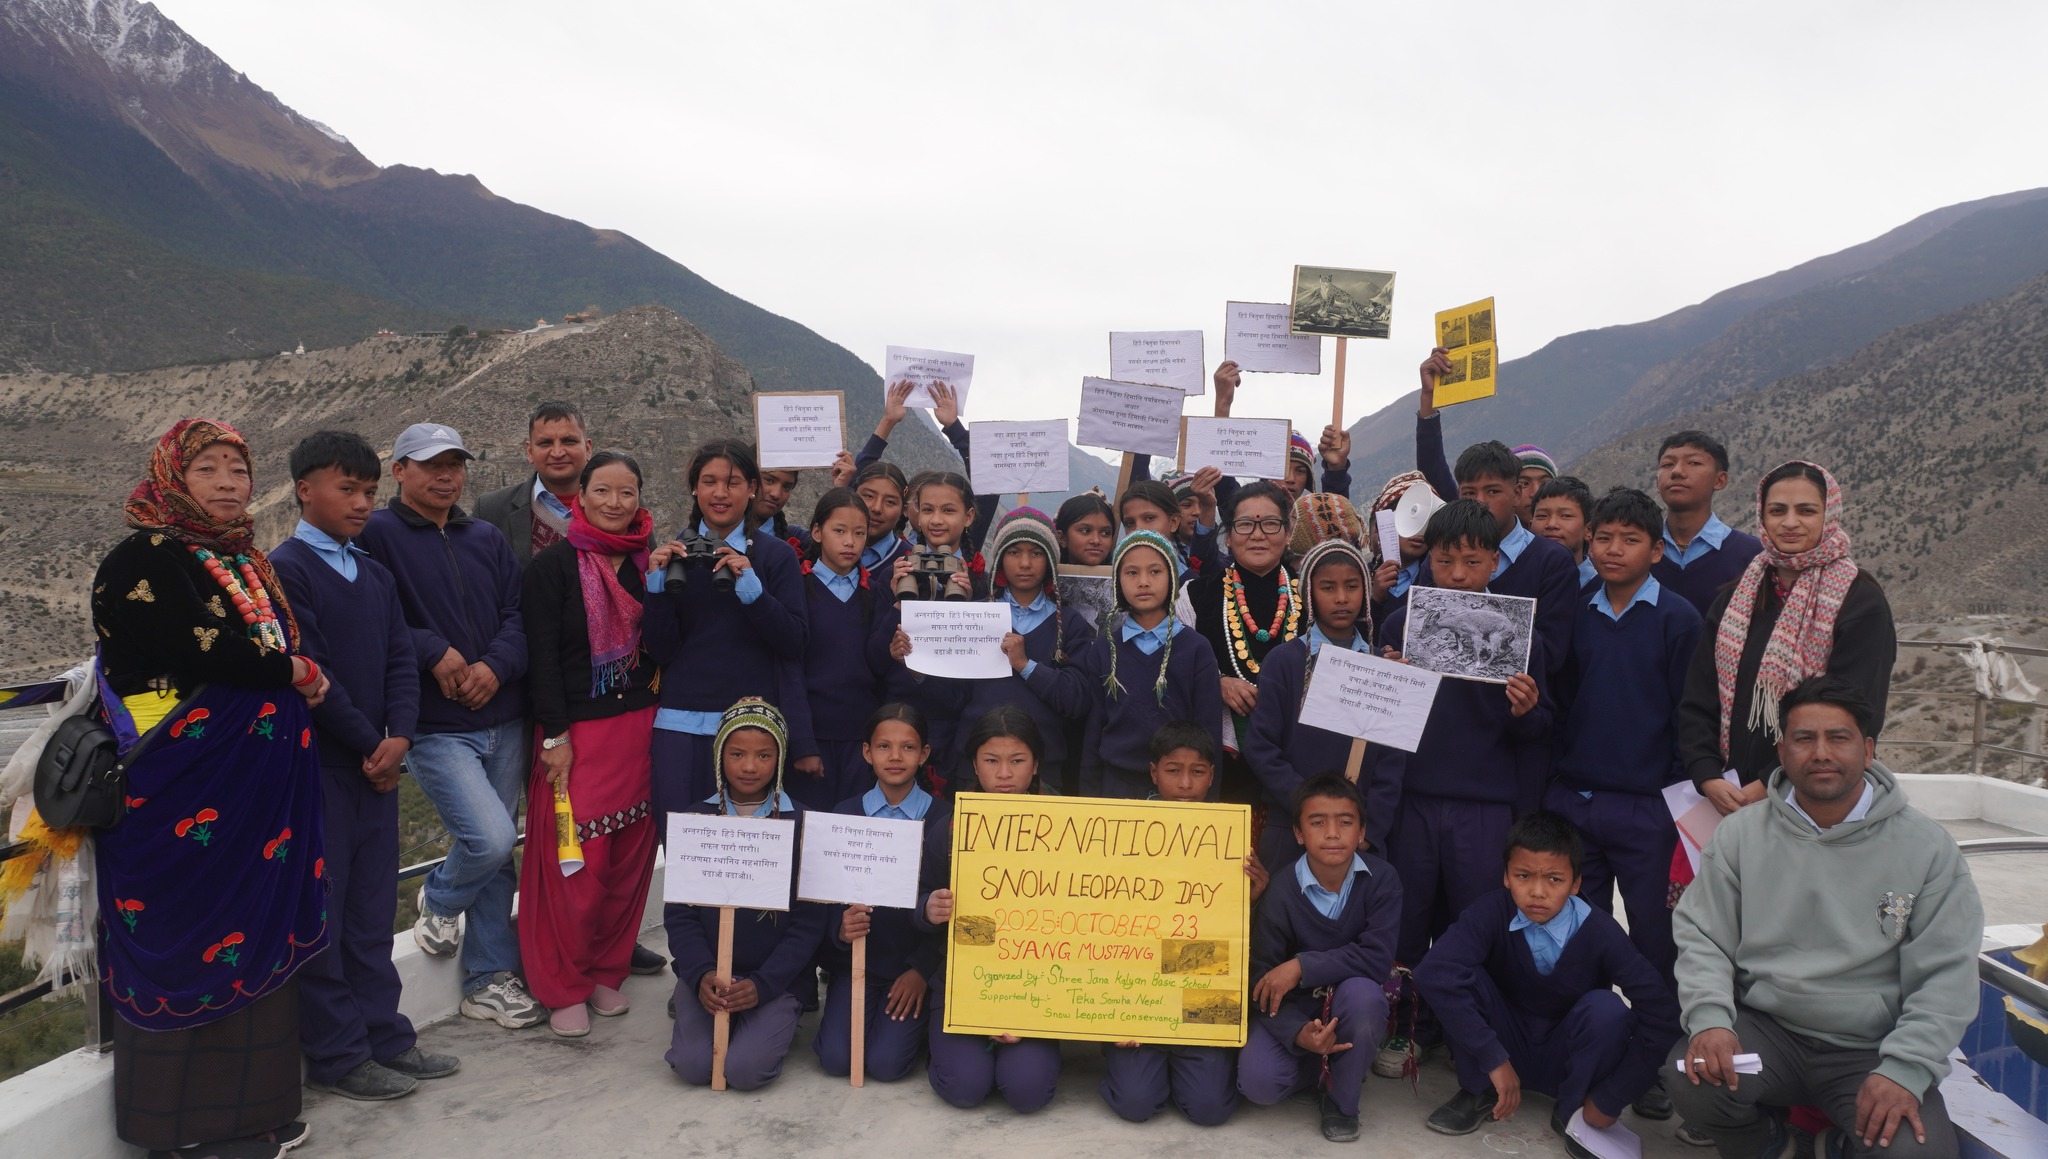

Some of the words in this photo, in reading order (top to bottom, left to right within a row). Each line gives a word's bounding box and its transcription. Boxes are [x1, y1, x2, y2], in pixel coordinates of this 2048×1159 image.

[958, 812, 1242, 860] INTERNATIONAL
[980, 865, 1060, 900] SNOW
[1067, 873, 1164, 901] LEOPARD
[1174, 881, 1223, 908] DAY
[1170, 914, 1198, 940] 23
[998, 938, 1071, 961] SYANG
[1077, 942, 1154, 961] MUSTANG
[973, 965, 1023, 988] Organized
[1046, 964, 1083, 985] Shree
[1086, 968, 1109, 985] Jana
[1115, 970, 1147, 990] Kalyan
[1151, 972, 1176, 987] Basic
[979, 989, 1028, 1004] Supported
[1066, 988, 1095, 1005] Teka
[1043, 1008, 1071, 1019] Snow
[1075, 1008, 1116, 1024] Leopard
